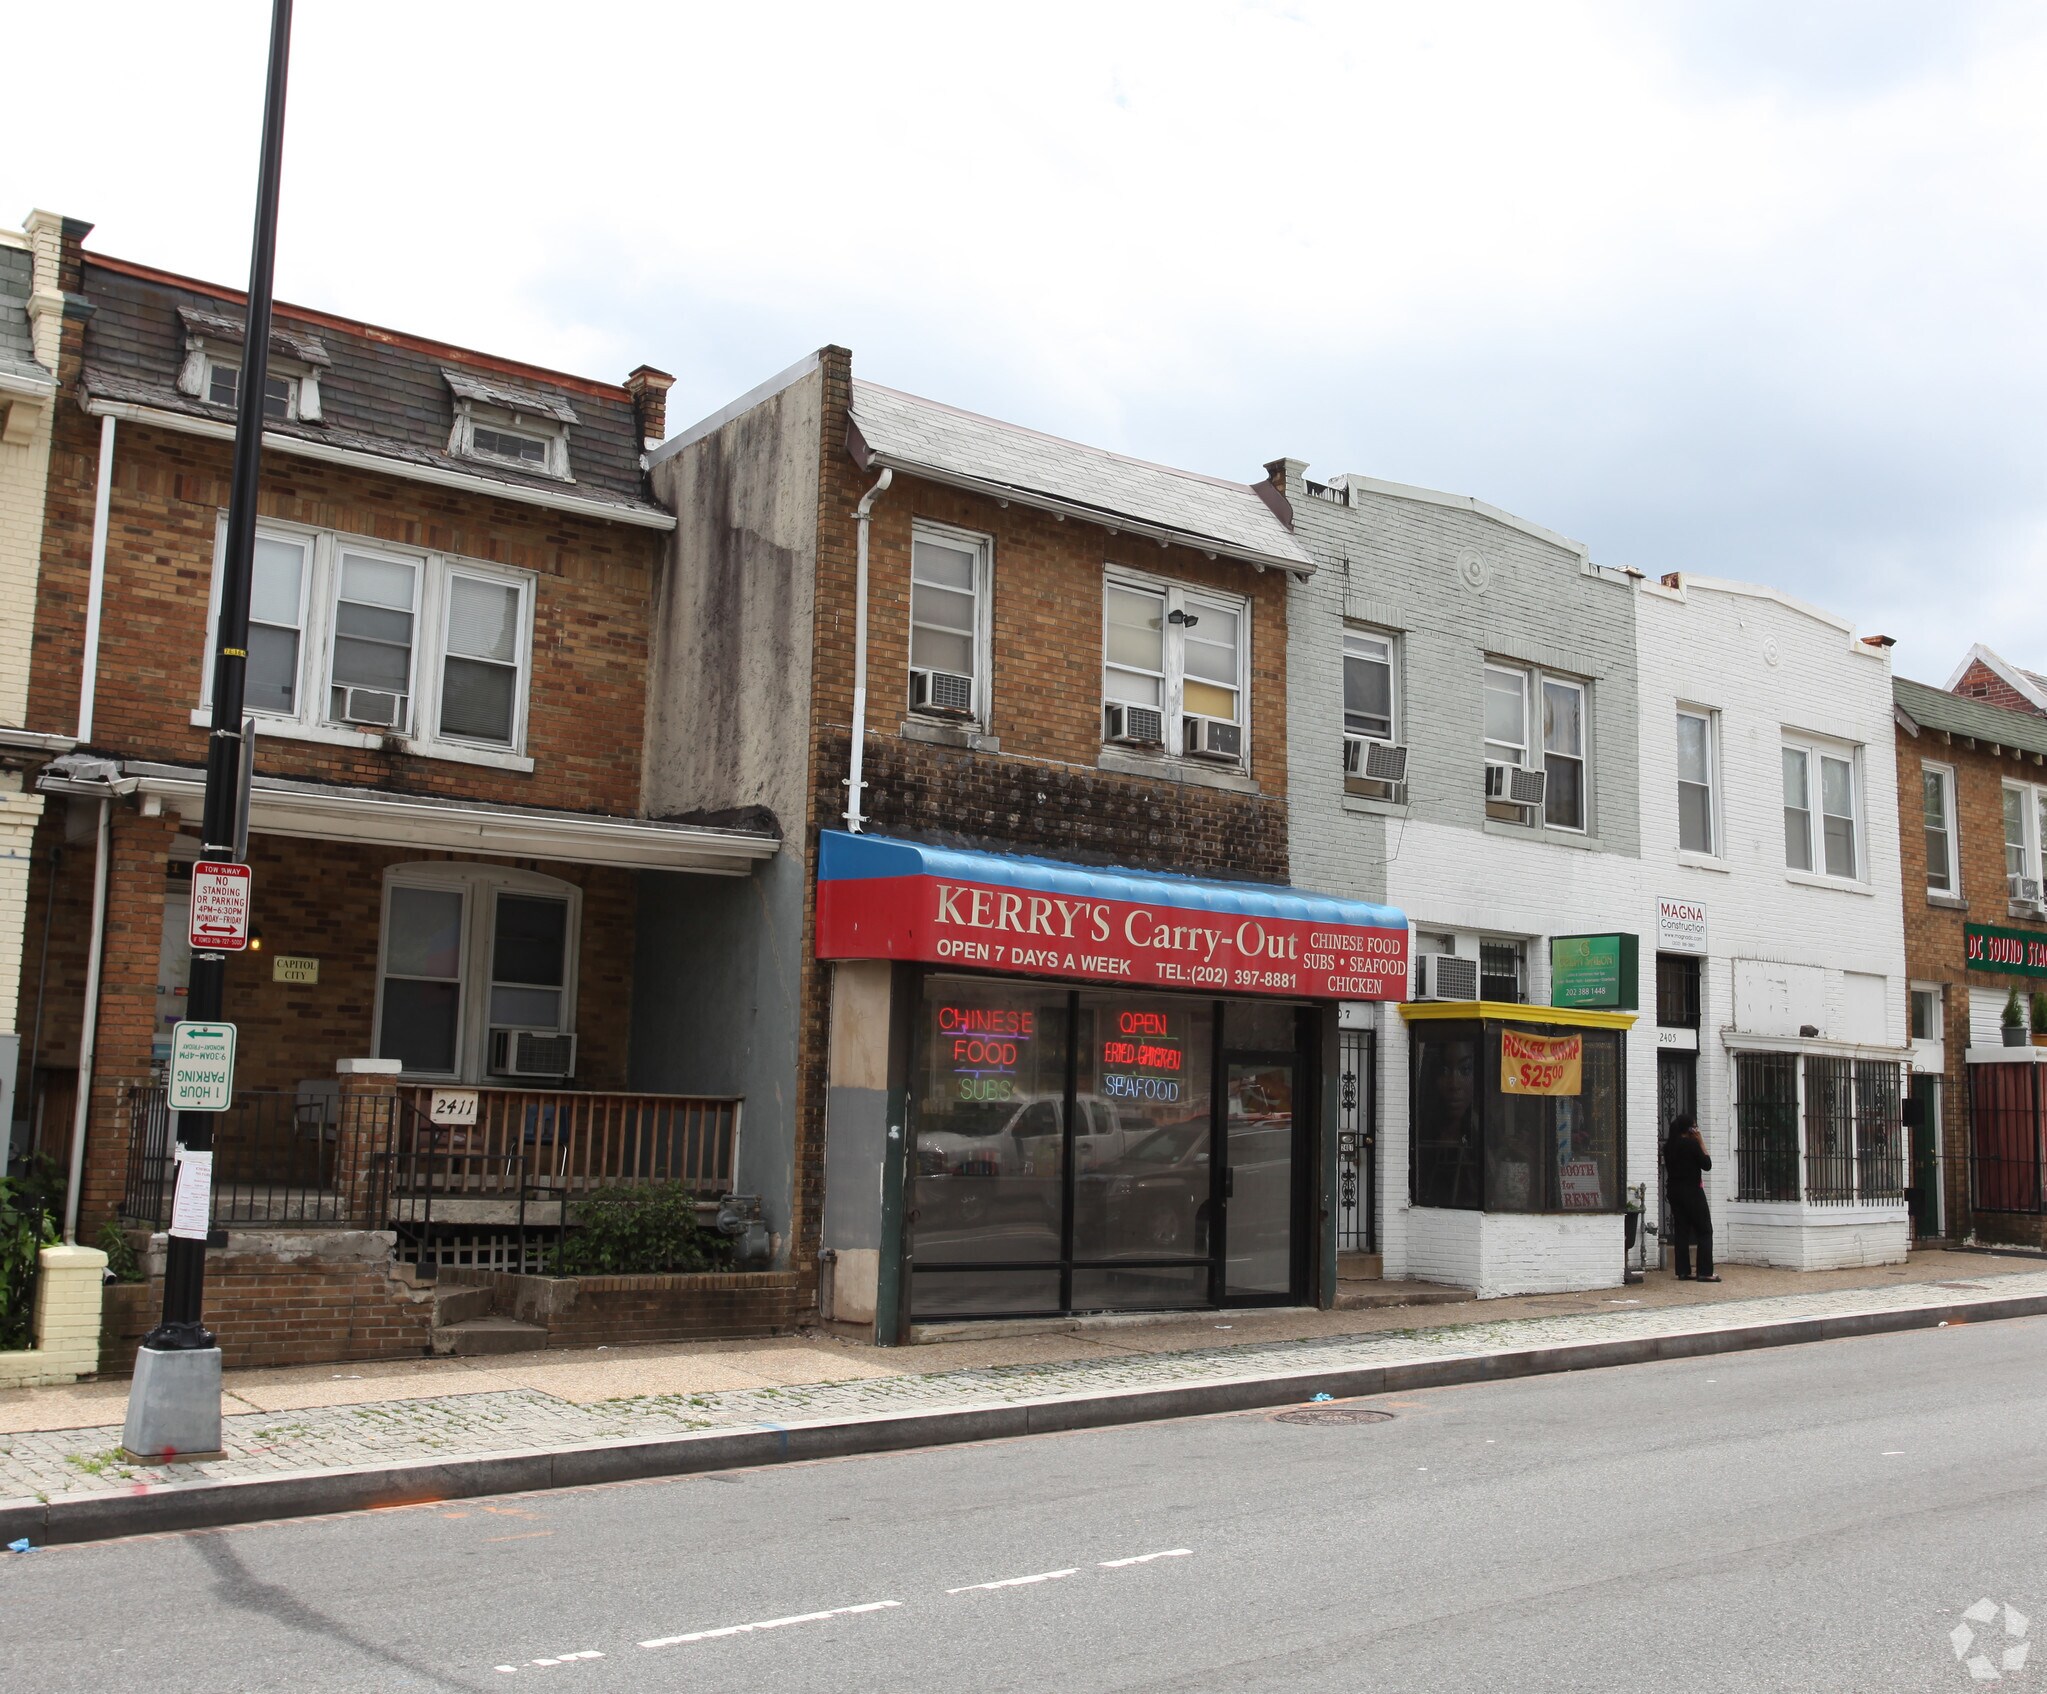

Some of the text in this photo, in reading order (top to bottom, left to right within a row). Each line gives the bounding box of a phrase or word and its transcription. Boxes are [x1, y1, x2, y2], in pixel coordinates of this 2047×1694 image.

[221, 867, 241, 875] AWAY
[216, 876, 229, 886] NO
[203, 886, 240, 897] STANDING
[197, 895, 245, 907] OR PARKING
[199, 905, 242, 915] 4PM-6:30PM
[1661, 902, 1704, 922] MAGNA
[934, 884, 1299, 962] KERRY'S Carry-Out
[1661, 918, 1705, 933] Construction
[1310, 932, 1401, 954] CHINESE FOOD
[1968, 934, 2047, 968] DC SOUND STA
[276, 959, 316, 971] CAPITOL
[937, 939, 1132, 976] OPEN 7 DAYS A WEEK
[1303, 952, 1406, 976] SUBS SEAFOOD
[284, 970, 307, 981] CITY
[1234, 969, 1297, 989] 397-8881
[1327, 975, 1383, 995] CHICKEN
[1565, 988, 1577, 997] 202
[1591, 987, 1607, 996] 1448
[939, 1007, 1033, 1033] CHINESE
[1120, 1011, 1168, 1035] OPEN
[1659, 1032, 1677, 1043] 2405
[953, 1040, 1017, 1065] FOOD
[1503, 1034, 1548, 1061] ROLLER
[179, 1051, 226, 1061] 9:30AM-4PM
[1138, 1045, 1182, 1071] CHICKEN
[177, 1070, 225, 1083] PARKING
[180, 1086, 220, 1098] 1 HOUR
[960, 1078, 1011, 1101] SUBS
[1105, 1075, 1179, 1101] SEAFOOD
[435, 1099, 474, 1115] 2411
[1561, 1180, 1576, 1190] for
[1563, 1192, 1599, 1208] RENT
